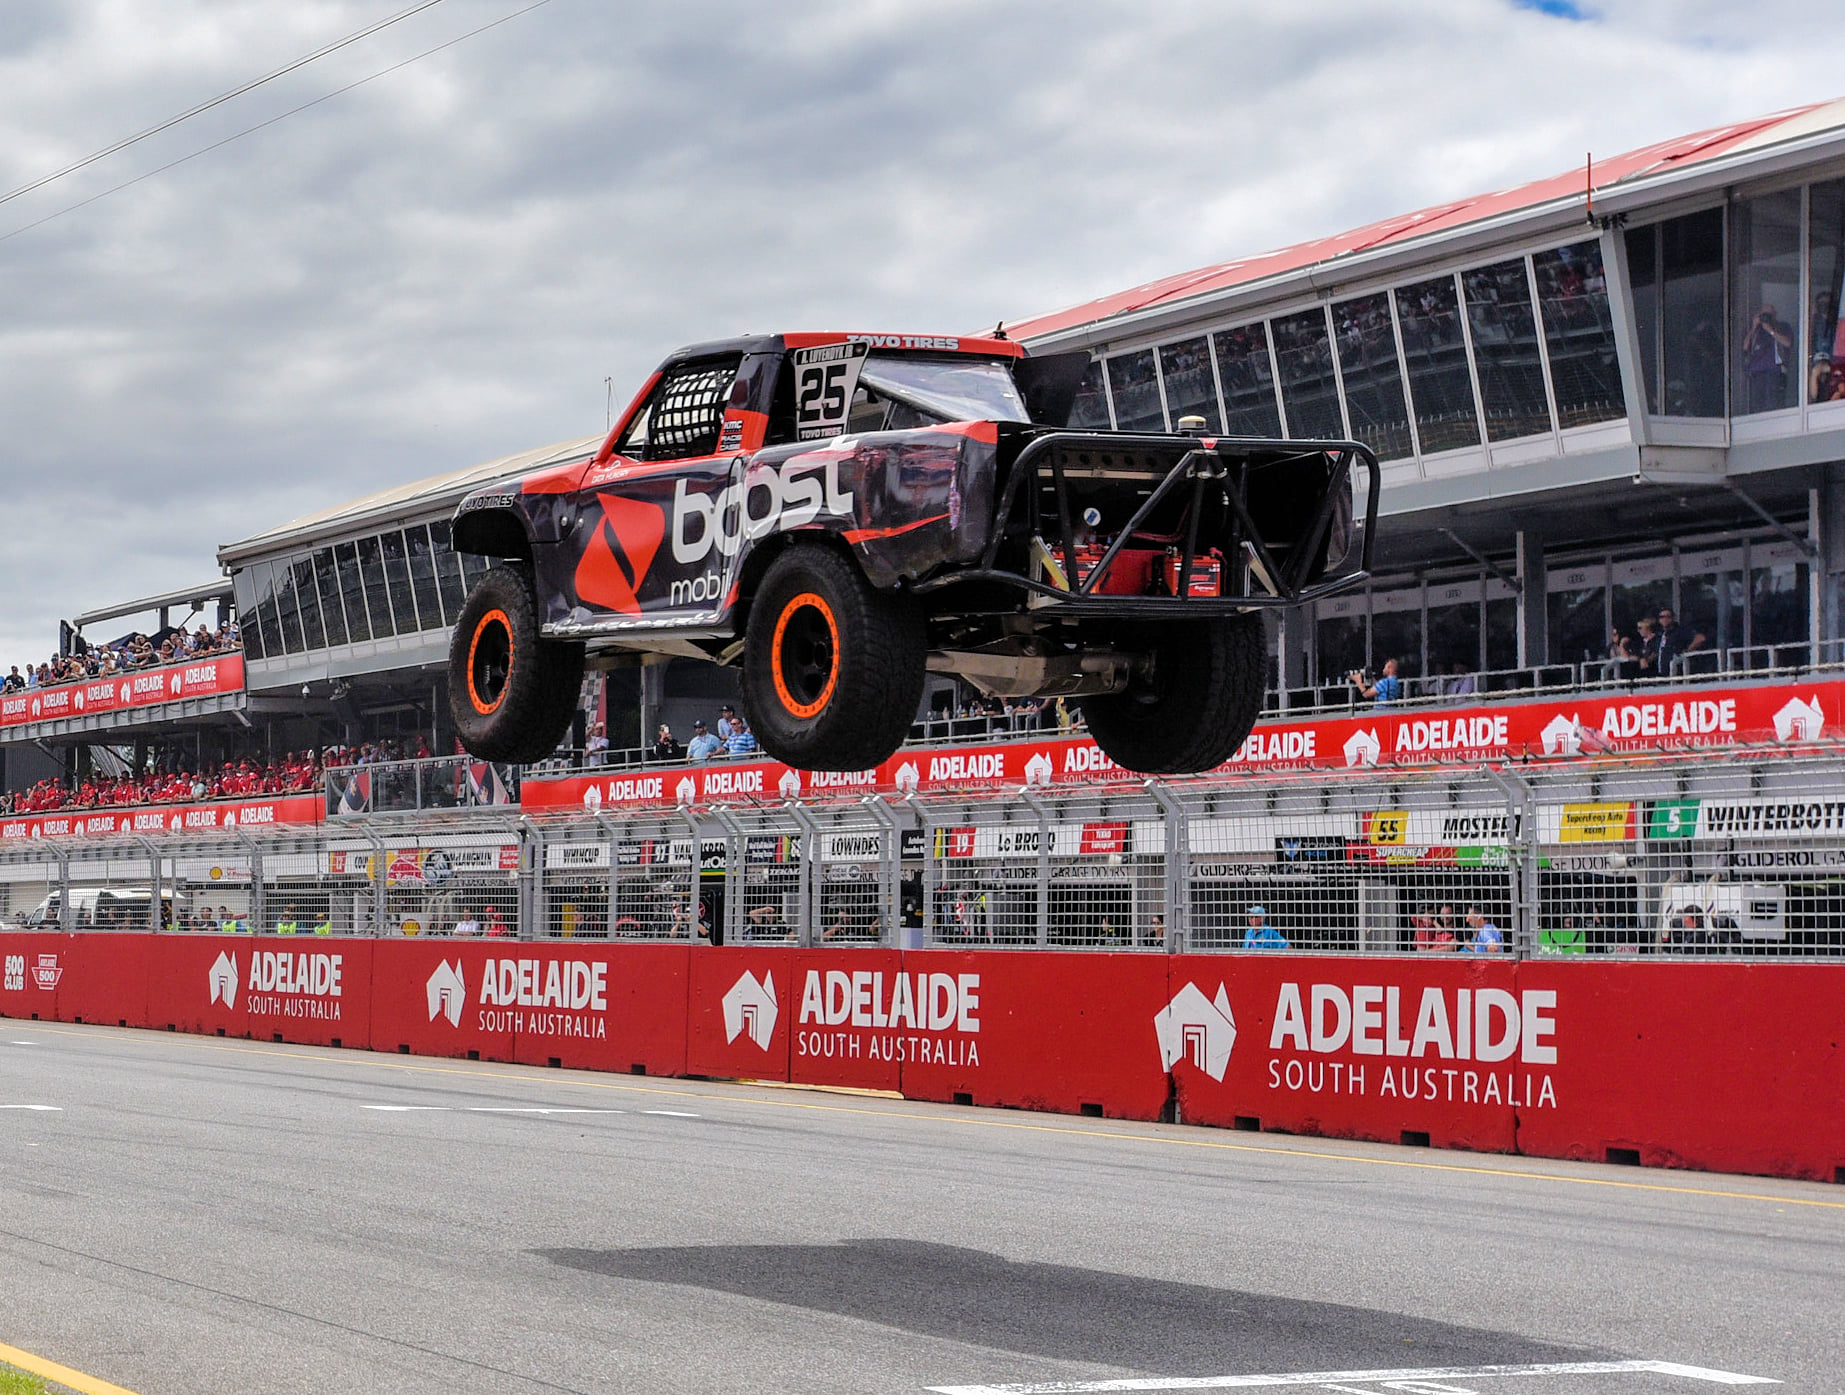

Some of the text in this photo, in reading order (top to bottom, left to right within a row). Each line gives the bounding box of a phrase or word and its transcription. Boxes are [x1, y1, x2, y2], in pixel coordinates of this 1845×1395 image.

[902, 337, 959, 350] TIRES
[800, 364, 847, 422] 25
[801, 426, 843, 439] TOYO TIRES
[462, 493, 515, 510] TOYO TIRES
[672, 434, 859, 564] boost
[670, 568, 733, 606] mobil
[185, 665, 216, 684] ADELAIDE
[87, 684, 114, 701] ADELAIDE
[134, 675, 163, 694] ADELAIDE
[3, 699, 26, 715] ADELAIDE
[43, 691, 68, 708] ADELAIDE
[1601, 699, 1736, 738] ADELAIDE
[1396, 716, 1508, 751] ADELAIDE
[1226, 731, 1316, 762] DELAIDE
[1610, 738, 1650, 752] OUTH
[929, 754, 1004, 780] ADELAIDE
[1064, 747, 1121, 773] ADEL
[704, 771, 763, 795] ADELAIDE
[810, 769, 876, 788] ADELAIDE
[608, 778, 663, 801] ADELAIDE
[134, 814, 163, 829] ADELAIDE
[186, 811, 216, 826] ADELAIDE
[240, 806, 273, 823] ADELAIDE
[1667, 809, 1681, 833] 5
[3, 823, 26, 838] ADELAIDE
[44, 820, 68, 834] ADELAIDE
[87, 817, 114, 832] ADELAIDE
[1377, 820, 1398, 841] 55
[832, 837, 880, 856] LOWNDES
[956, 833, 969, 853] 19
[998, 832, 1056, 852] Le BROQ
[655, 845, 667, 862] 97
[1375, 847, 1430, 858] SUPERCHEAP
[1736, 851, 1819, 867] GLIDEROL
[1571, 856, 1611, 870] DOOR
[5, 955, 24, 976] 500
[249, 951, 342, 997] ADELAIDE
[4, 975, 24, 990] CLUB
[39, 970, 55, 982] 500
[479, 958, 608, 1010] ADELAIDE
[247, 995, 341, 1021] SOUTH AUSTRALIA
[799, 970, 980, 1033] ADELAIDE
[478, 1010, 606, 1039] SOUTH AUSTRALIA
[1269, 982, 1557, 1065] ADELAIDE
[798, 1031, 980, 1067] SOUTH AUSTRALIA
[1268, 1059, 1557, 1109] SOUTH AUSTRALIA
